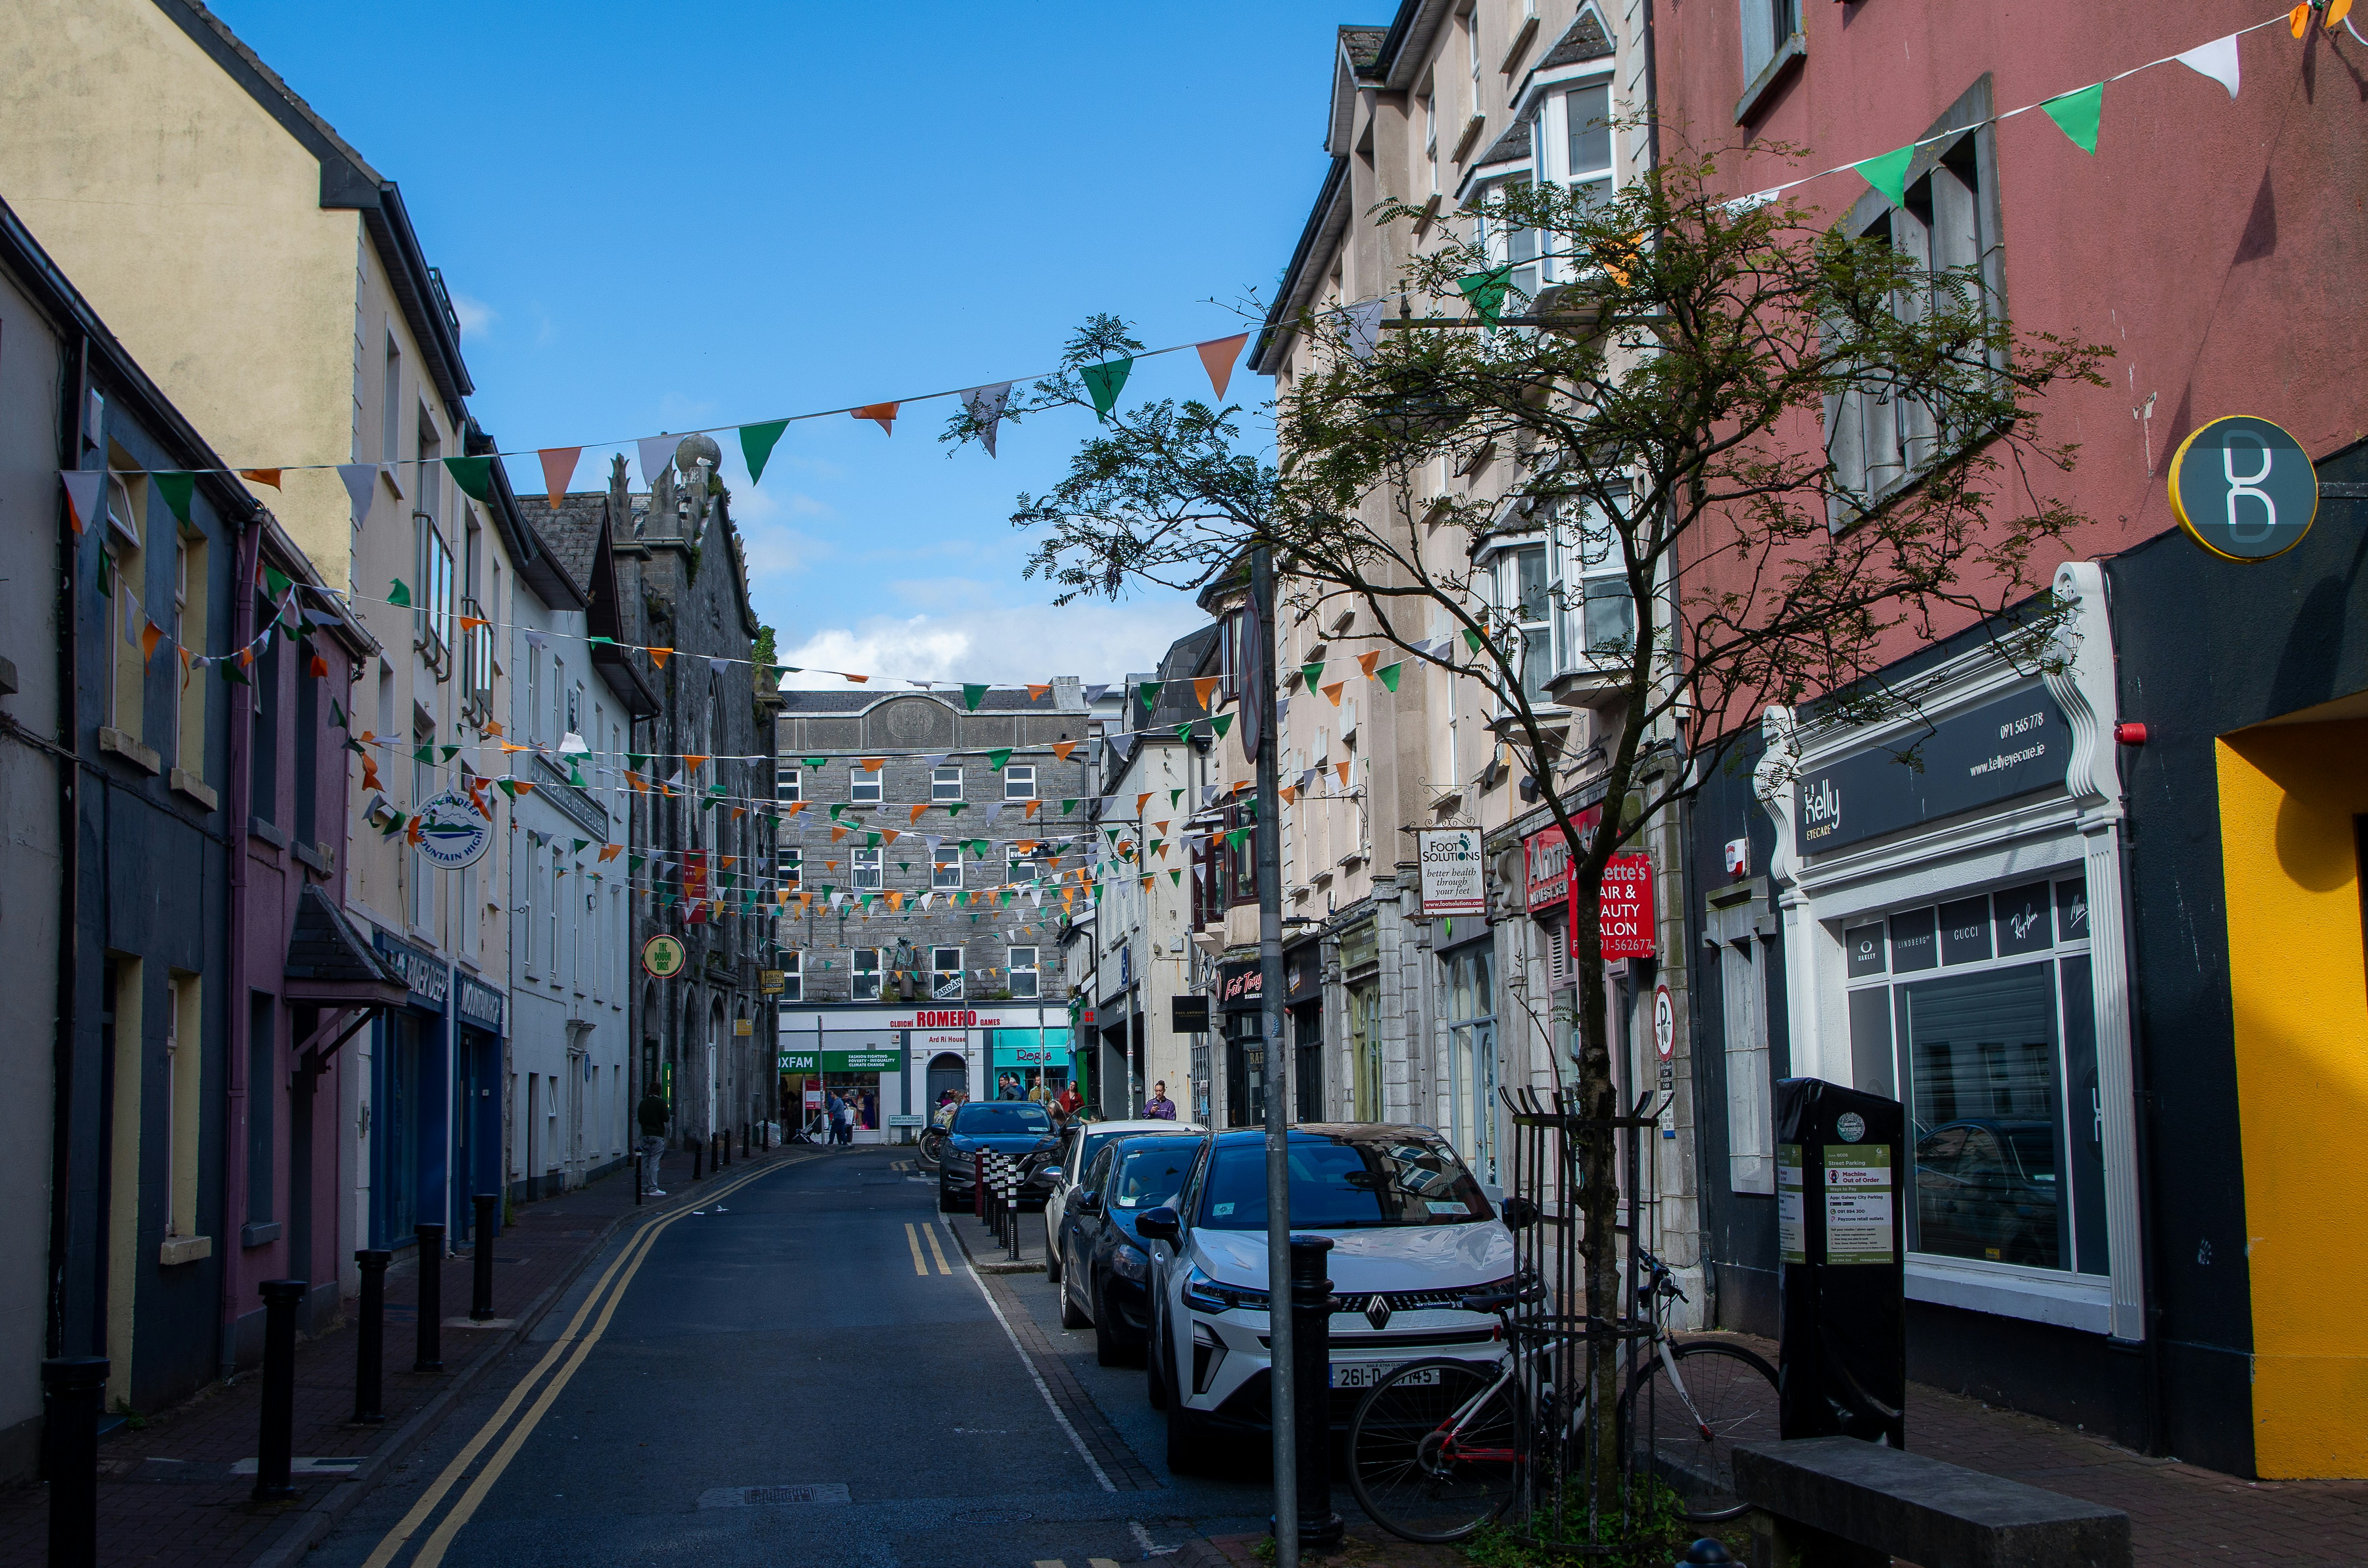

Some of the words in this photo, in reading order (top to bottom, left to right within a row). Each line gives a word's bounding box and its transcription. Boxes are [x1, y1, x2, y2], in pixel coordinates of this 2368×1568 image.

[2000, 723, 2013, 739] 091
[2015, 718, 2028, 734] 565
[2030, 712, 2043, 729] 778
[1970, 742, 2045, 776] www.kellyeyecare.ie
[457, 797, 480, 817] DEEP
[1804, 779, 1839, 829] Kelly
[1807, 824, 1831, 841] EYECARE
[418, 831, 462, 861] MOUNTAIN
[463, 831, 483, 856] HIGH
[1430, 841, 1458, 852] FOOT
[1422, 851, 1480, 862] SOLUTIONS
[1427, 869, 1450, 877] better
[1452, 868, 1476, 877] health
[1437, 877, 1467, 887] through
[1435, 889, 1454, 897] your
[1455, 887, 1469, 897] feet
[1600, 886, 1621, 899] AIR
[1625, 884, 1636, 899] &
[1600, 904, 1640, 918] AUTY
[1600, 922, 1637, 936] ALON
[1954, 926, 1978, 940] GUCCI
[659, 943, 667, 952] THE
[1898, 937, 1926, 948] LINDBERG
[654, 952, 671, 961] DOUGH
[1858, 953, 1875, 961] OAKLEY
[657, 961, 669, 970] BROS
[407, 955, 429, 996] RIVER
[427, 965, 447, 1003] DEEP
[1225, 977, 1243, 1001] Fat
[461, 981, 489, 1022] MOUNTAIN
[890, 1018, 913, 1028] CLUICHÍ
[917, 1010, 977, 1027] ROMERO
[1660, 1001, 1667, 1046] P
[1016, 1049, 1052, 1065] Regs
